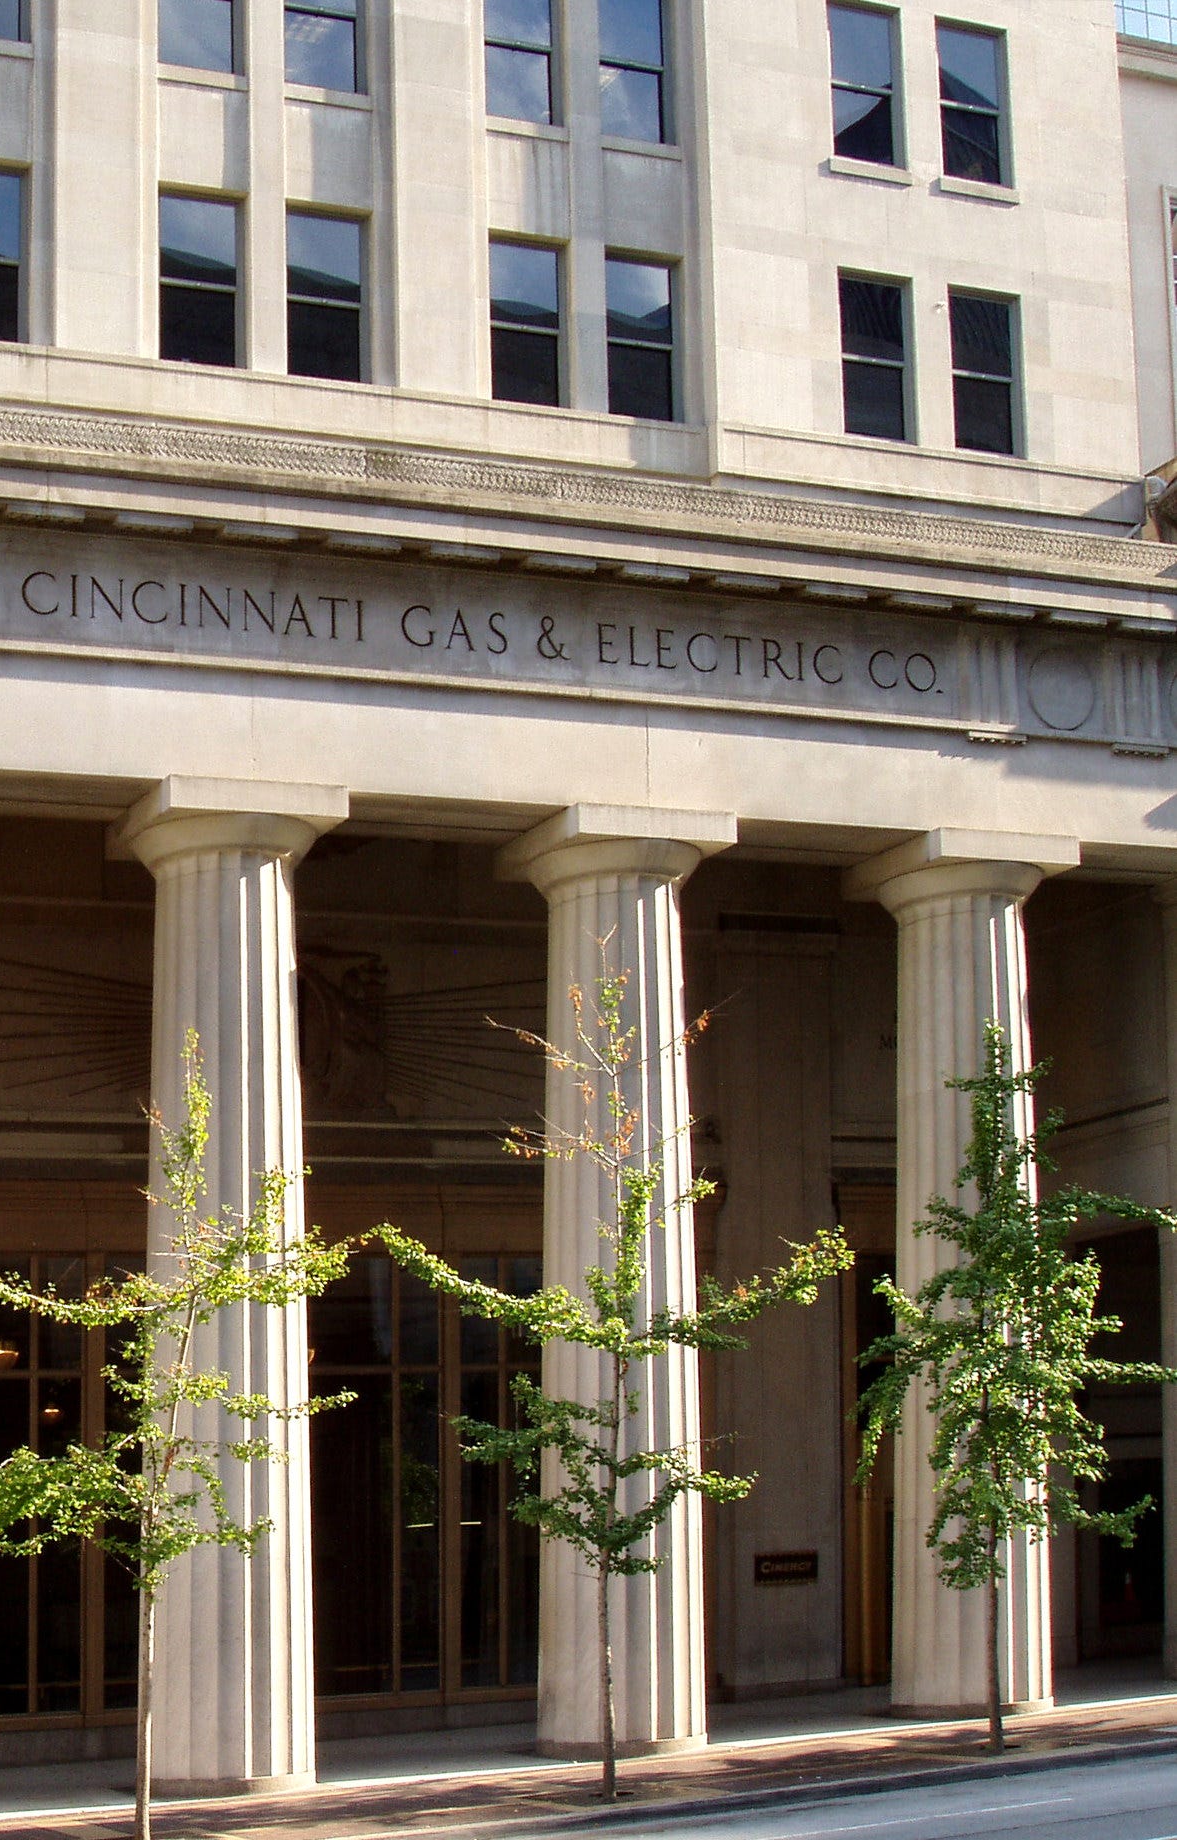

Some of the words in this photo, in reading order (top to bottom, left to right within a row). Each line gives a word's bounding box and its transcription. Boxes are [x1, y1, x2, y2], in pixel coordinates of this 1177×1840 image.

[21, 570, 365, 643] CINCINNATI
[401, 604, 509, 655] GAS
[536, 615, 571, 661] &
[596, 622, 844, 685] ELECTRIC
[867, 649, 944, 695] CO.
